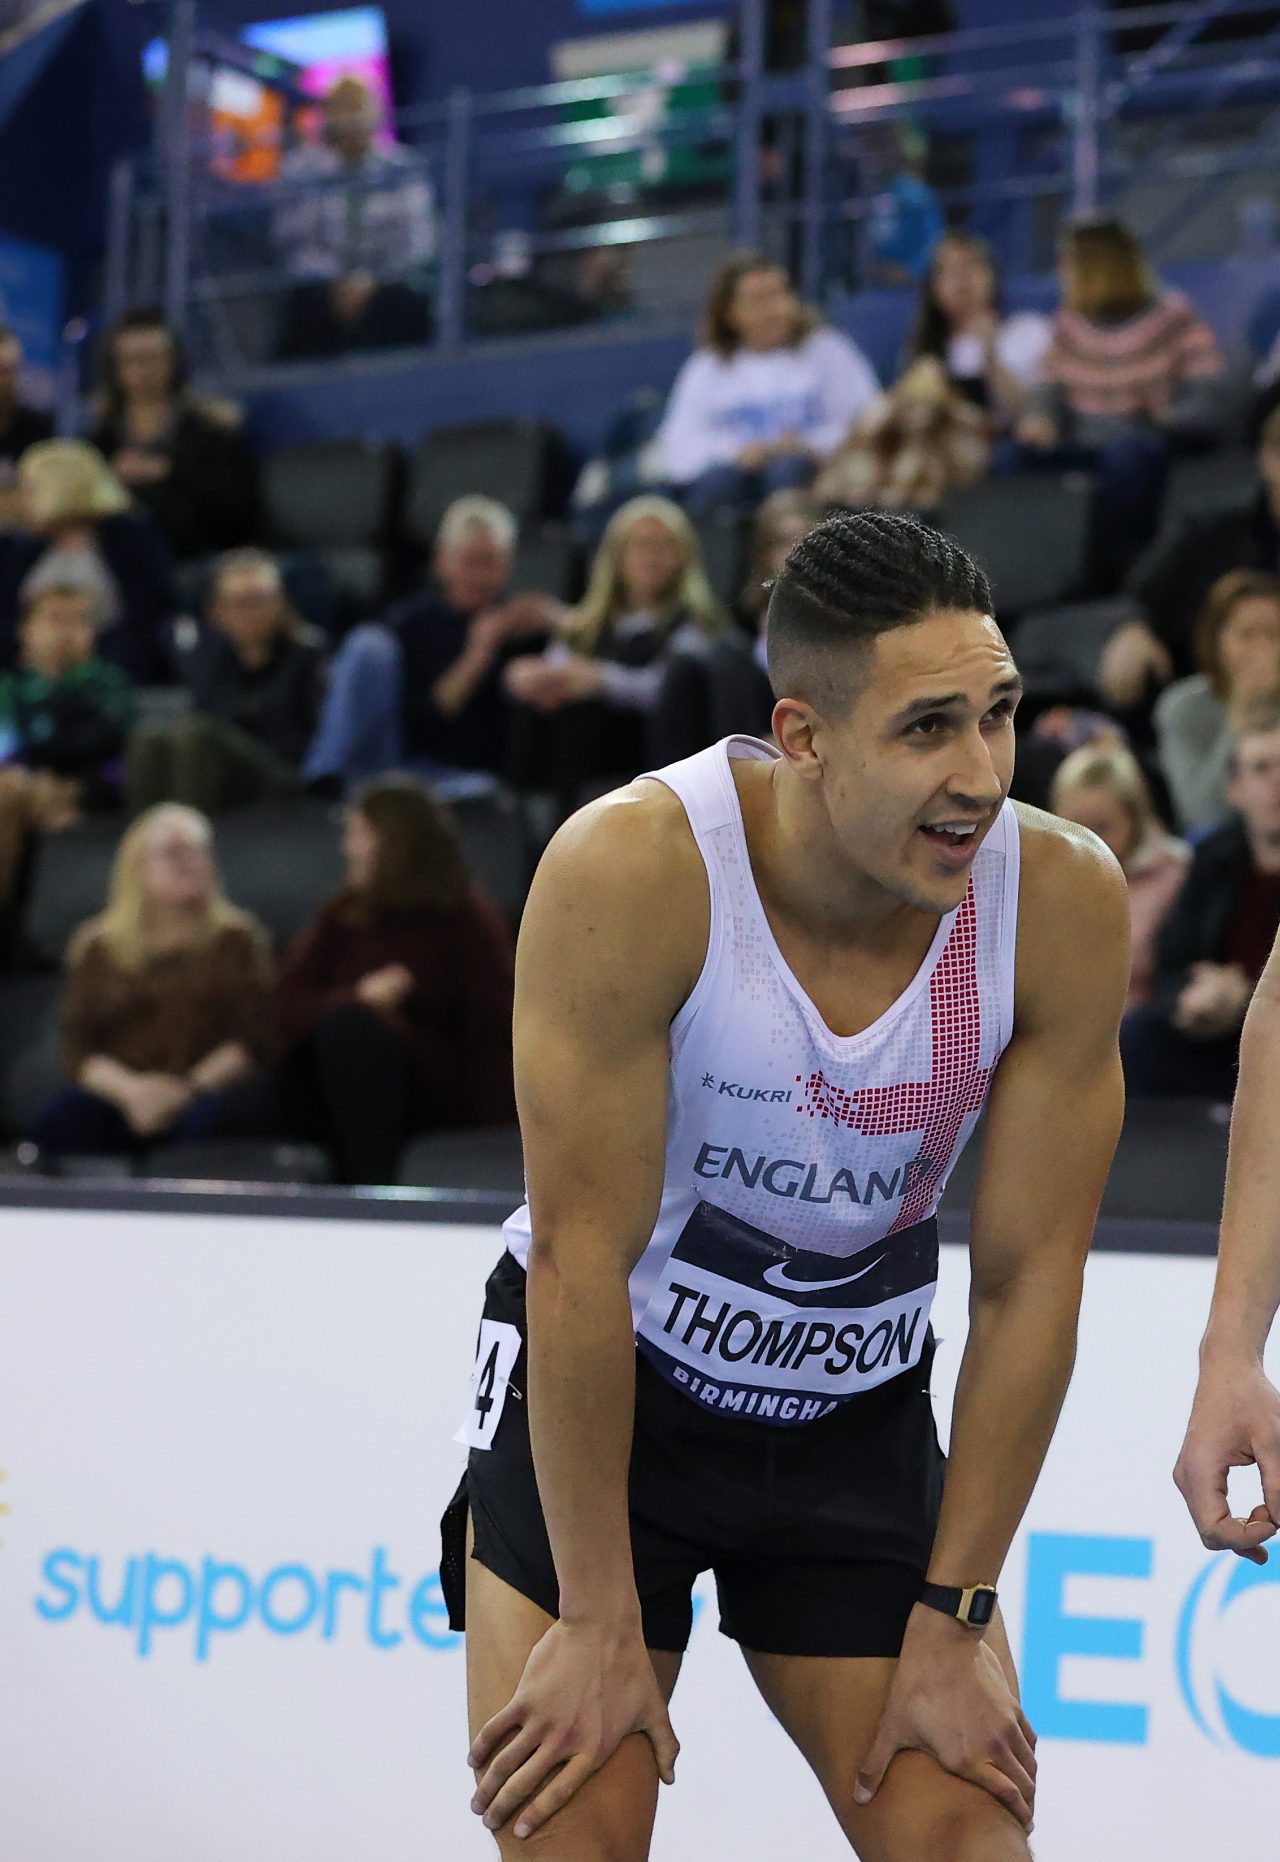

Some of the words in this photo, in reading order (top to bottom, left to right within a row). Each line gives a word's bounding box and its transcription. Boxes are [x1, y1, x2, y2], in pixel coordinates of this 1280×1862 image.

[717, 1081, 793, 1103] KUKRI
[693, 1142, 934, 1206] ENGLAND
[662, 1283, 922, 1376] THOMPSON
[475, 1340, 500, 1430] 4
[672, 1366, 839, 1421] BIRMINGHA
[34, 1545, 462, 1662] supporte
